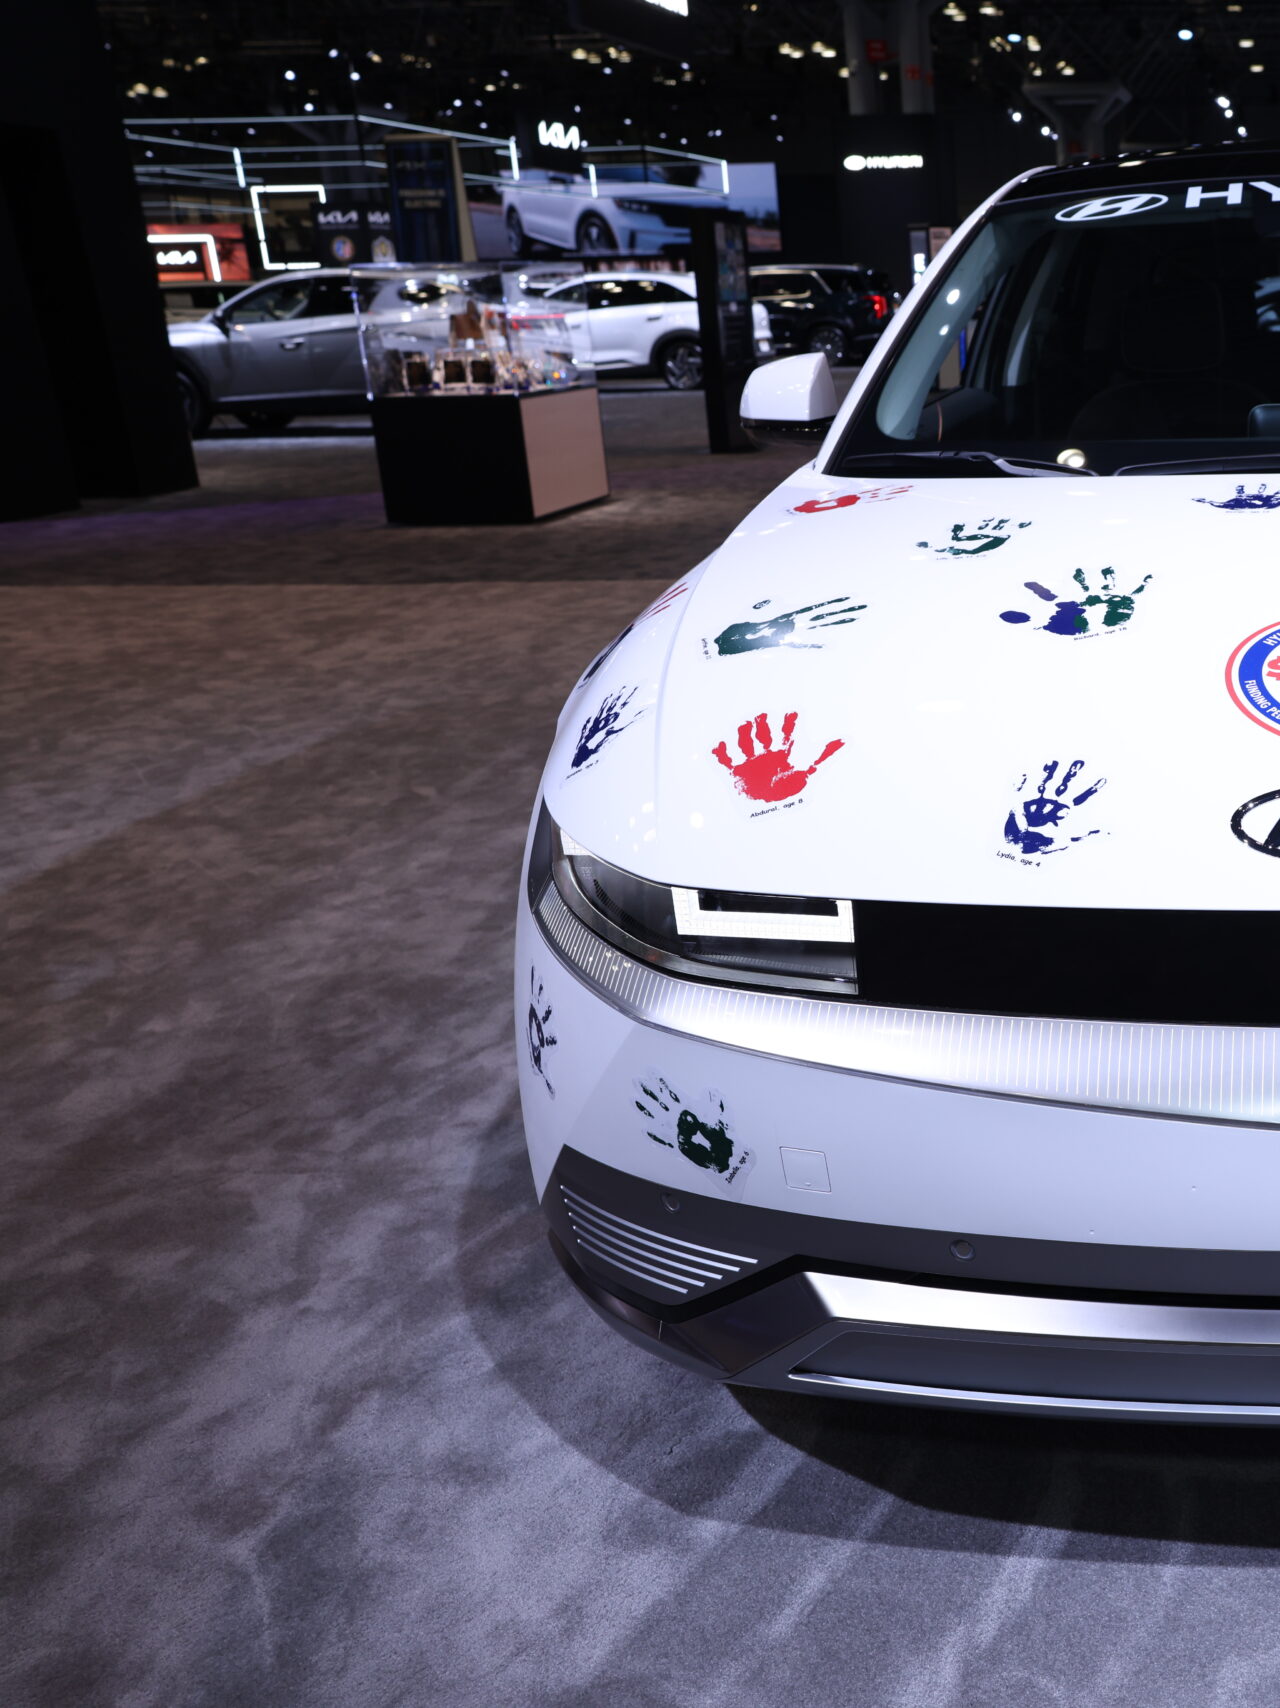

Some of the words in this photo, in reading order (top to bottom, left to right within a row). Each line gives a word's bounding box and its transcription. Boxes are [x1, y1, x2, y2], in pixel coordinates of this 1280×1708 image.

[1244, 679, 1272, 709] FUNDING
[782, 801, 796, 809] age
[1020, 858, 1033, 866] age
